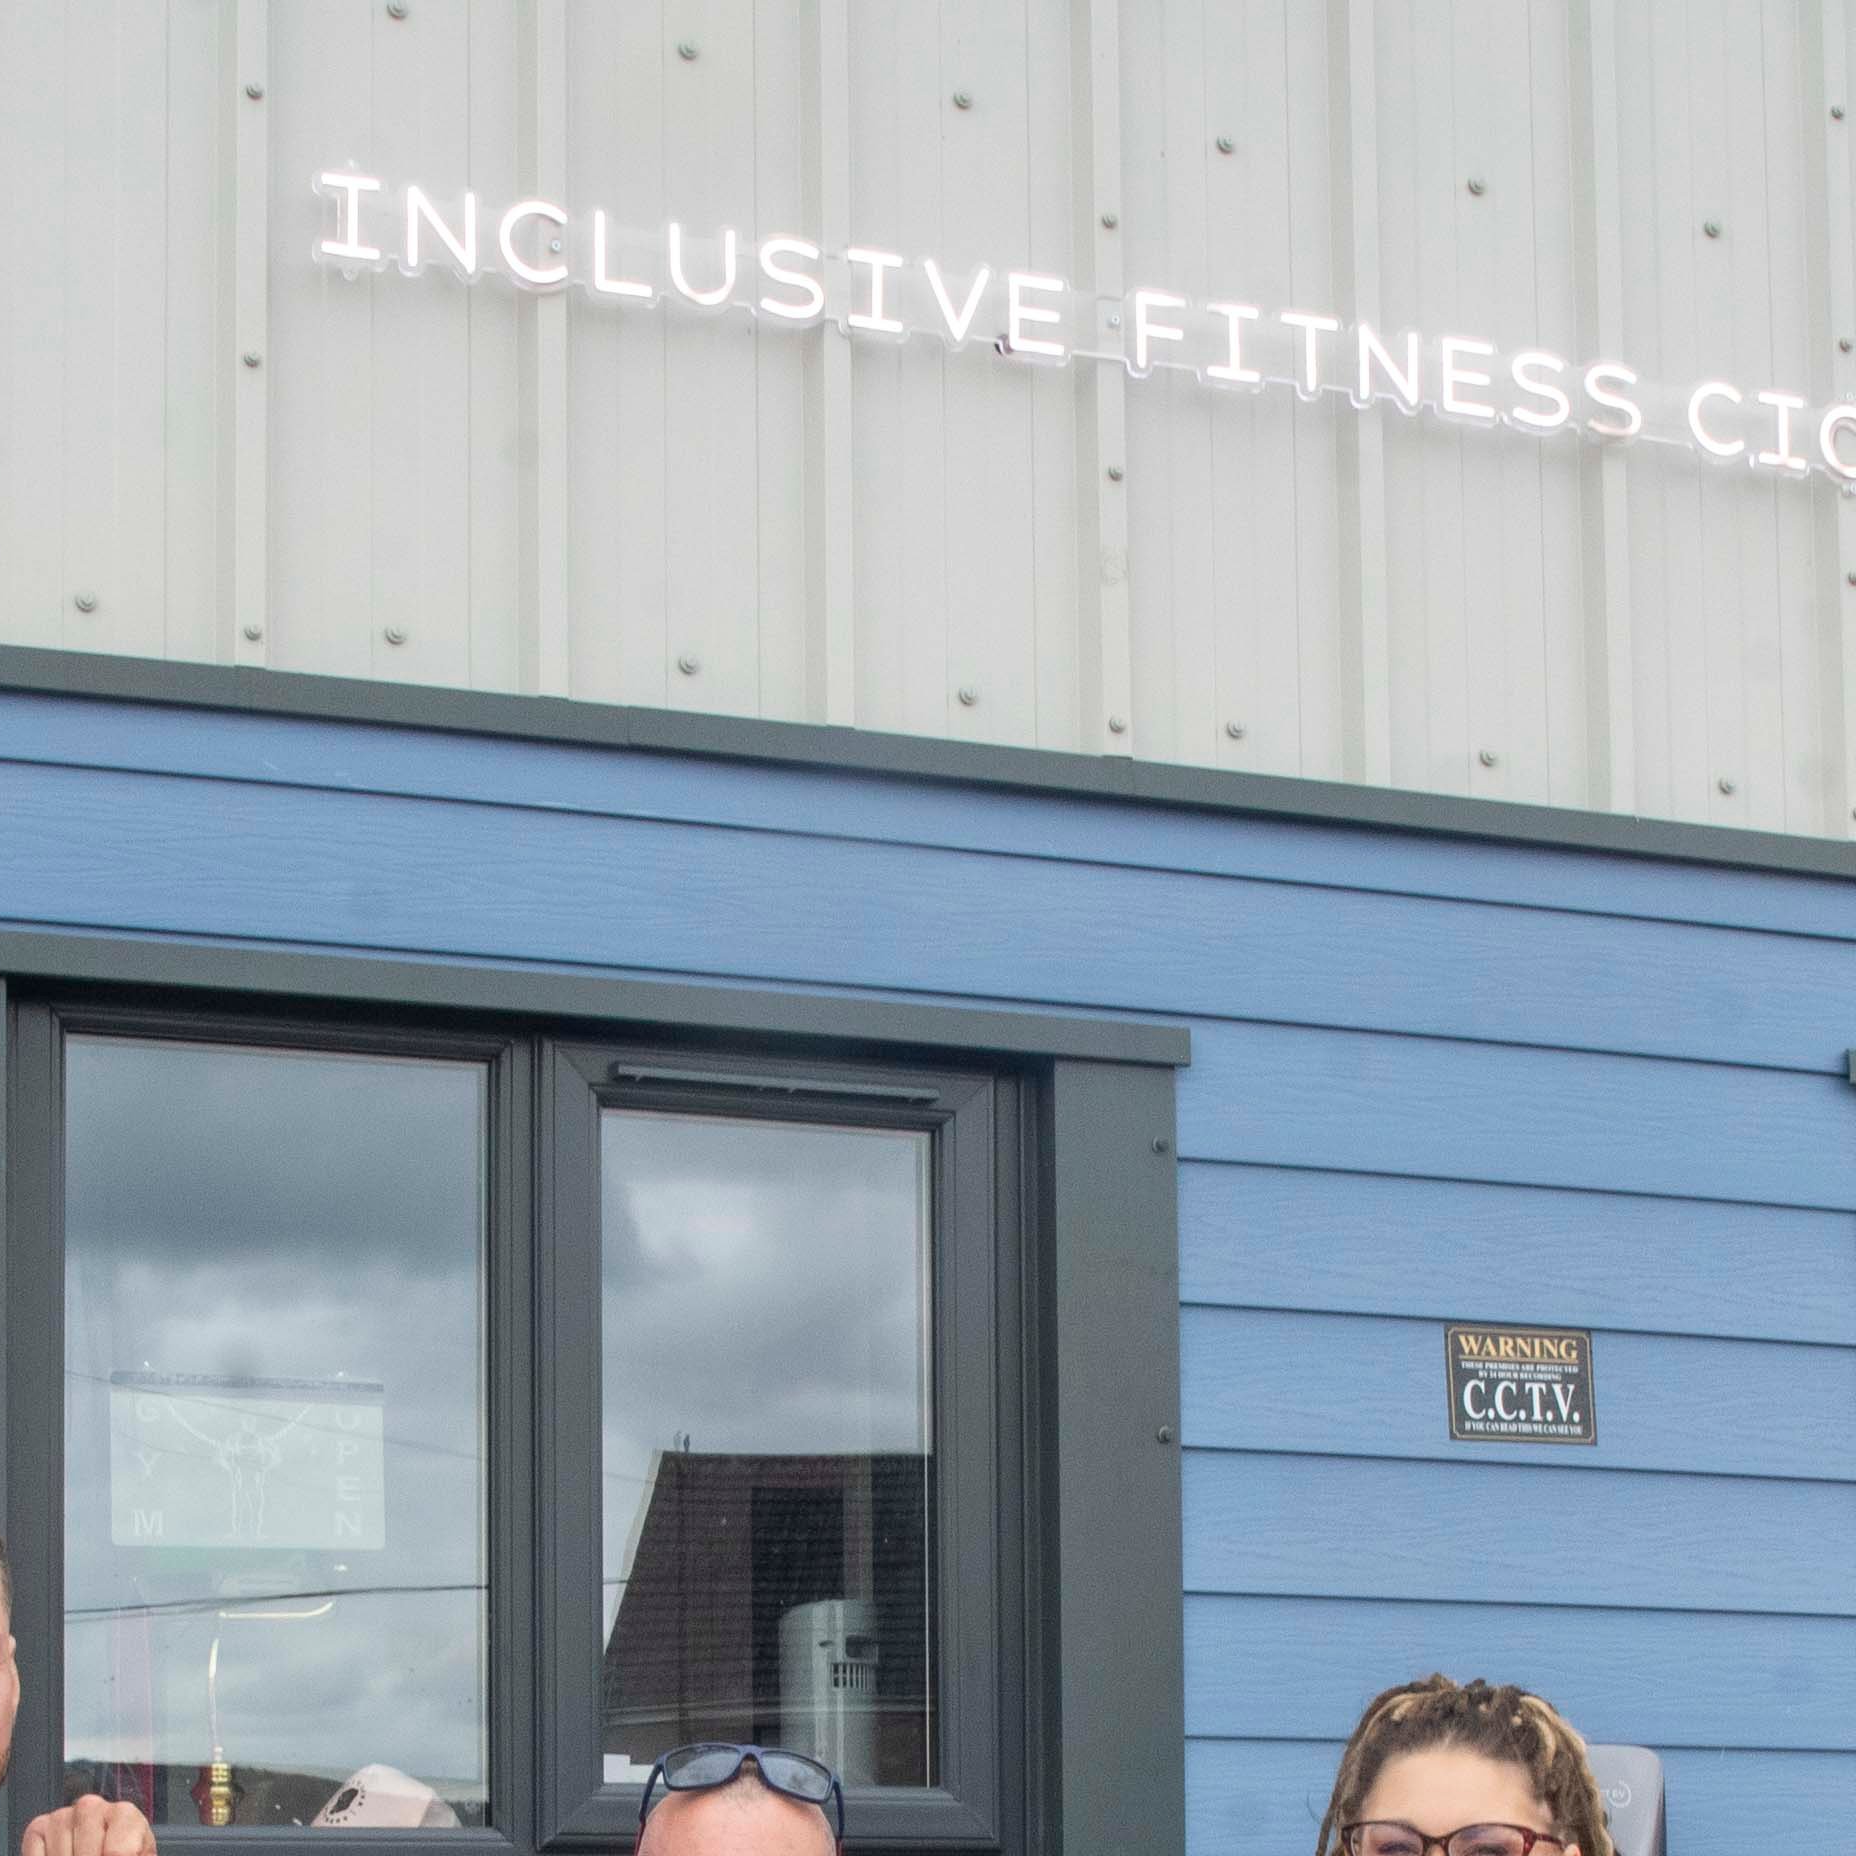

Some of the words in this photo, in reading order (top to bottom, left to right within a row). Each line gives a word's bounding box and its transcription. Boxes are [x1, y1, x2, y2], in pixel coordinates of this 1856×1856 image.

[319, 170, 1067, 357] INCLUSIVE
[1133, 289, 1644, 439] FITNESS
[1457, 1334, 1579, 1361] WARNING
[1463, 1378, 1580, 1423] C.C.T.V.
